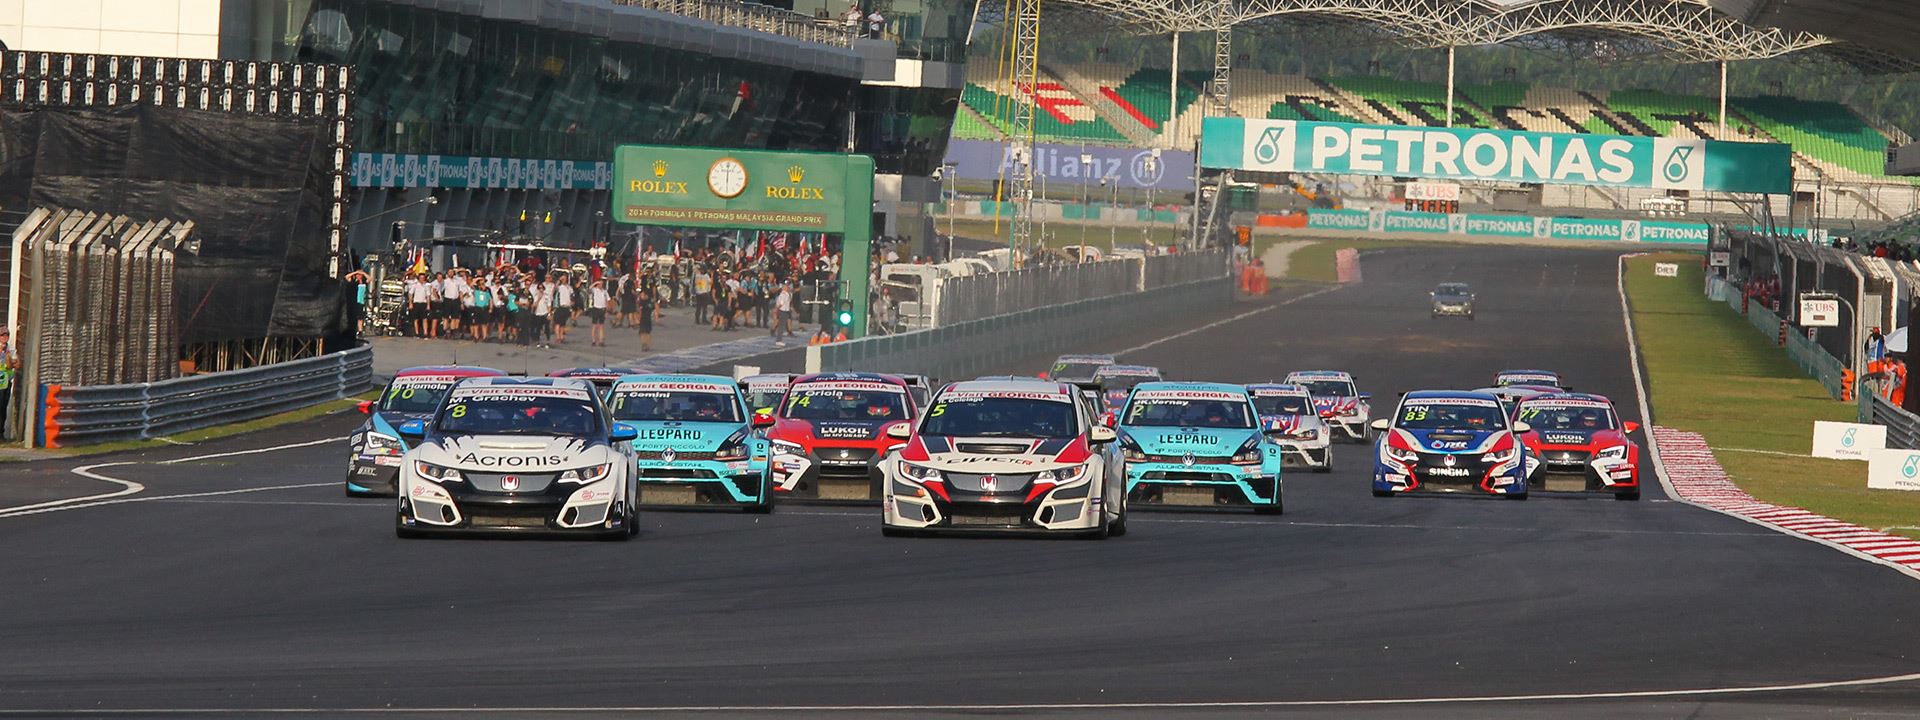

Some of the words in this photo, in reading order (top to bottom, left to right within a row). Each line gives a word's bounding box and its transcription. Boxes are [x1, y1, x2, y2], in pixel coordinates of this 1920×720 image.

[1311, 125, 1636, 184] PETRONAS
[999, 146, 1122, 180] Alianz
[440, 165, 468, 178] TRONAS
[630, 179, 689, 194] ROLEX
[766, 185, 825, 200] ROLEX
[1426, 185, 1456, 199] UBS
[629, 209, 649, 217] 2016
[650, 210, 686, 218] FORMULA
[694, 211, 735, 220] PETRONAS
[736, 213, 775, 222] MALAYSIA
[776, 215, 802, 223] GRAND
[803, 216, 822, 224] PRIX
[1309, 212, 1369, 227] PETRONAS
[1386, 216, 1446, 230] PETRONAS
[1466, 219, 1533, 234] PETRONAS
[1553, 222, 1620, 237] PETRONAS
[1642, 225, 1709, 240] PETRONAS
[1815, 303, 1834, 312] UBS
[504, 389, 570, 397] GEORGIA
[659, 384, 717, 392] GEORGIA
[835, 383, 889, 391] GEORGIA
[988, 391, 1052, 400] GEORGIA
[1176, 391, 1231, 399] GEORGIA
[617, 397, 625, 410] 1
[788, 396, 811, 408] 74
[452, 404, 468, 418] 8
[930, 404, 946, 417] 5
[1132, 404, 1144, 416] 2
[1406, 405, 1430, 413] TIN
[1520, 409, 1541, 419] 77
[1404, 411, 1427, 421] 83
[640, 428, 702, 441] LEOPARD
[820, 427, 870, 435] LUKOIL
[1159, 434, 1218, 445] LEOPARD
[459, 453, 562, 467] Acronis
[1009, 458, 1032, 466] TCR
[1428, 468, 1471, 477] SINGHA
[1895, 480, 1920, 488] PETRON
